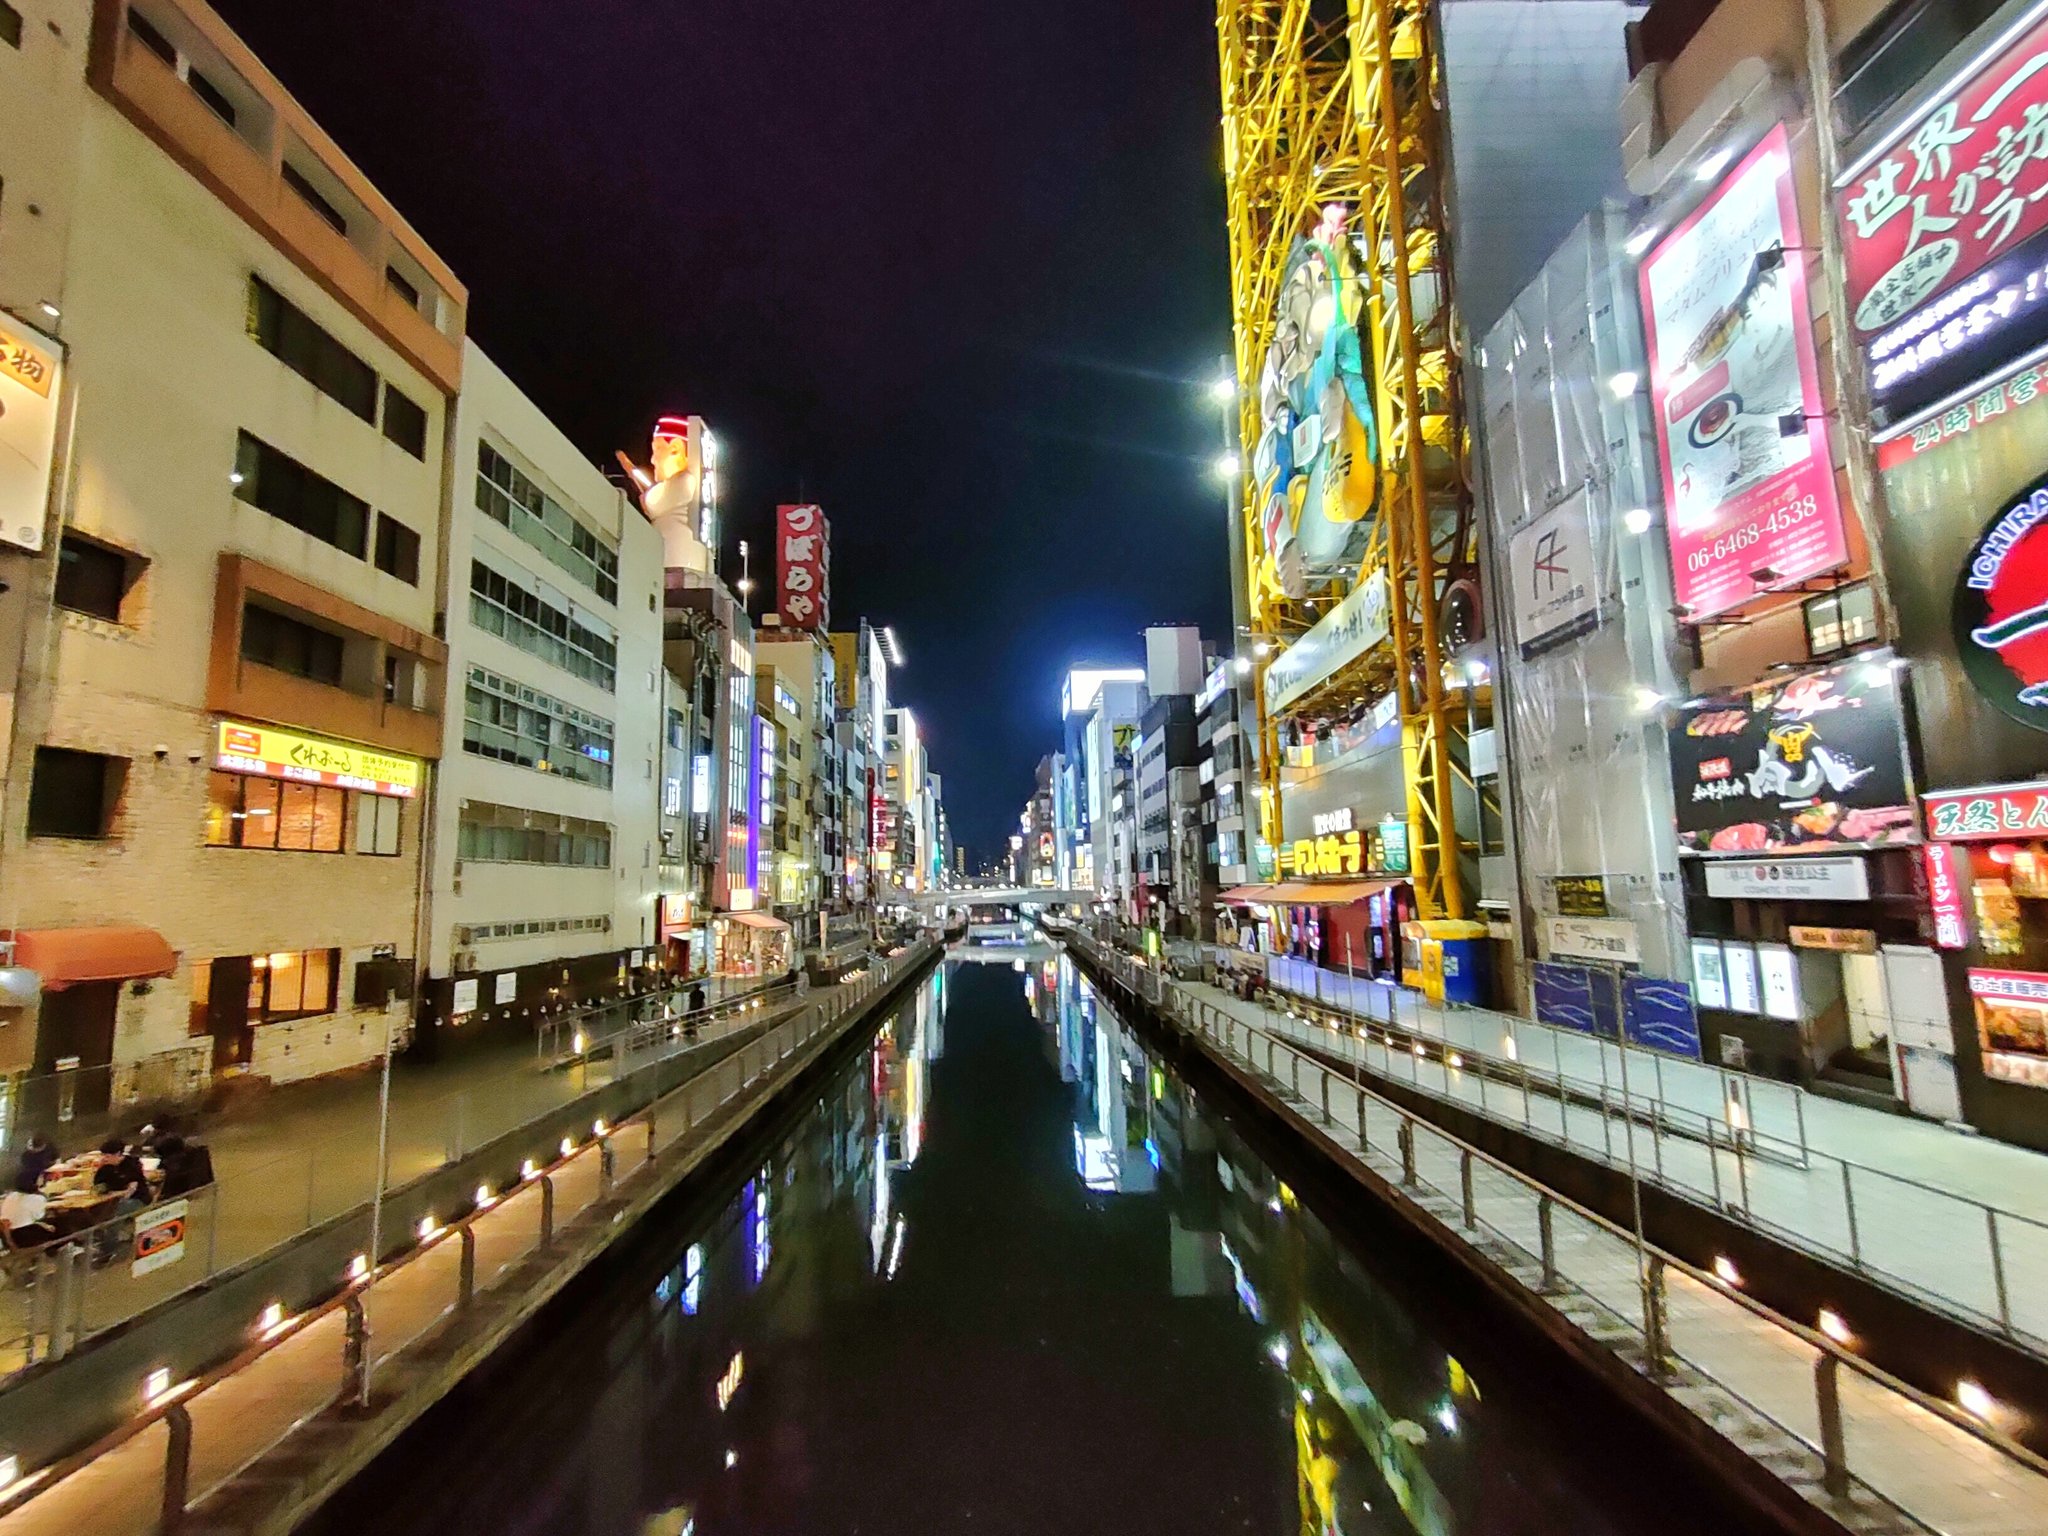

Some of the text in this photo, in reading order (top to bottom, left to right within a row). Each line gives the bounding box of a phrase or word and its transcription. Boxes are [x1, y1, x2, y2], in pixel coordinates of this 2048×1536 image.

[1687, 493, 1818, 573] 06-6468-4538
[289, 743, 352, 773] くれおーる
